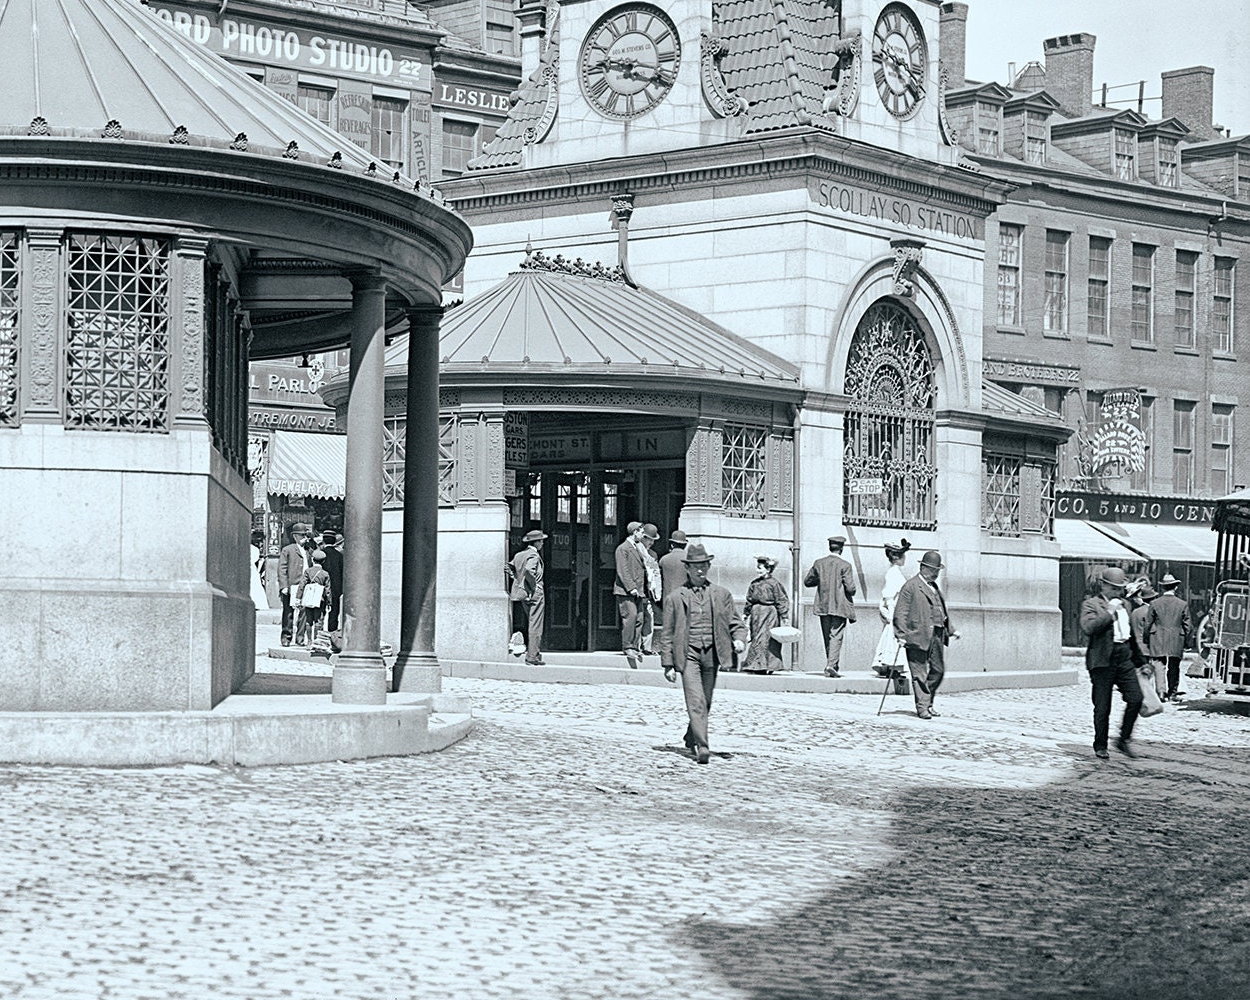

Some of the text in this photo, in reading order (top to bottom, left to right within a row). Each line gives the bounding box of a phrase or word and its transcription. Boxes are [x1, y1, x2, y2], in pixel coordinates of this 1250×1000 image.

[149, 6, 211, 45] ORD
[222, 19, 300, 61] PHOTO
[309, 36, 394, 76] STUDIO
[441, 83, 511, 111] LESLIE
[818, 182, 975, 240] SCOLLAY SQ STATION
[1112, 407, 1128, 416] 22
[254, 411, 317, 429] TREMONT
[505, 424, 524, 435] CARS
[505, 436, 527, 450] GERS
[637, 438, 658, 451] IN
[271, 479, 324, 493] JEWELRY
[850, 480, 858, 493] 2
[859, 484, 880, 493] STOP
[1057, 497, 1216, 523] CO. 5 AND 10 CEN
